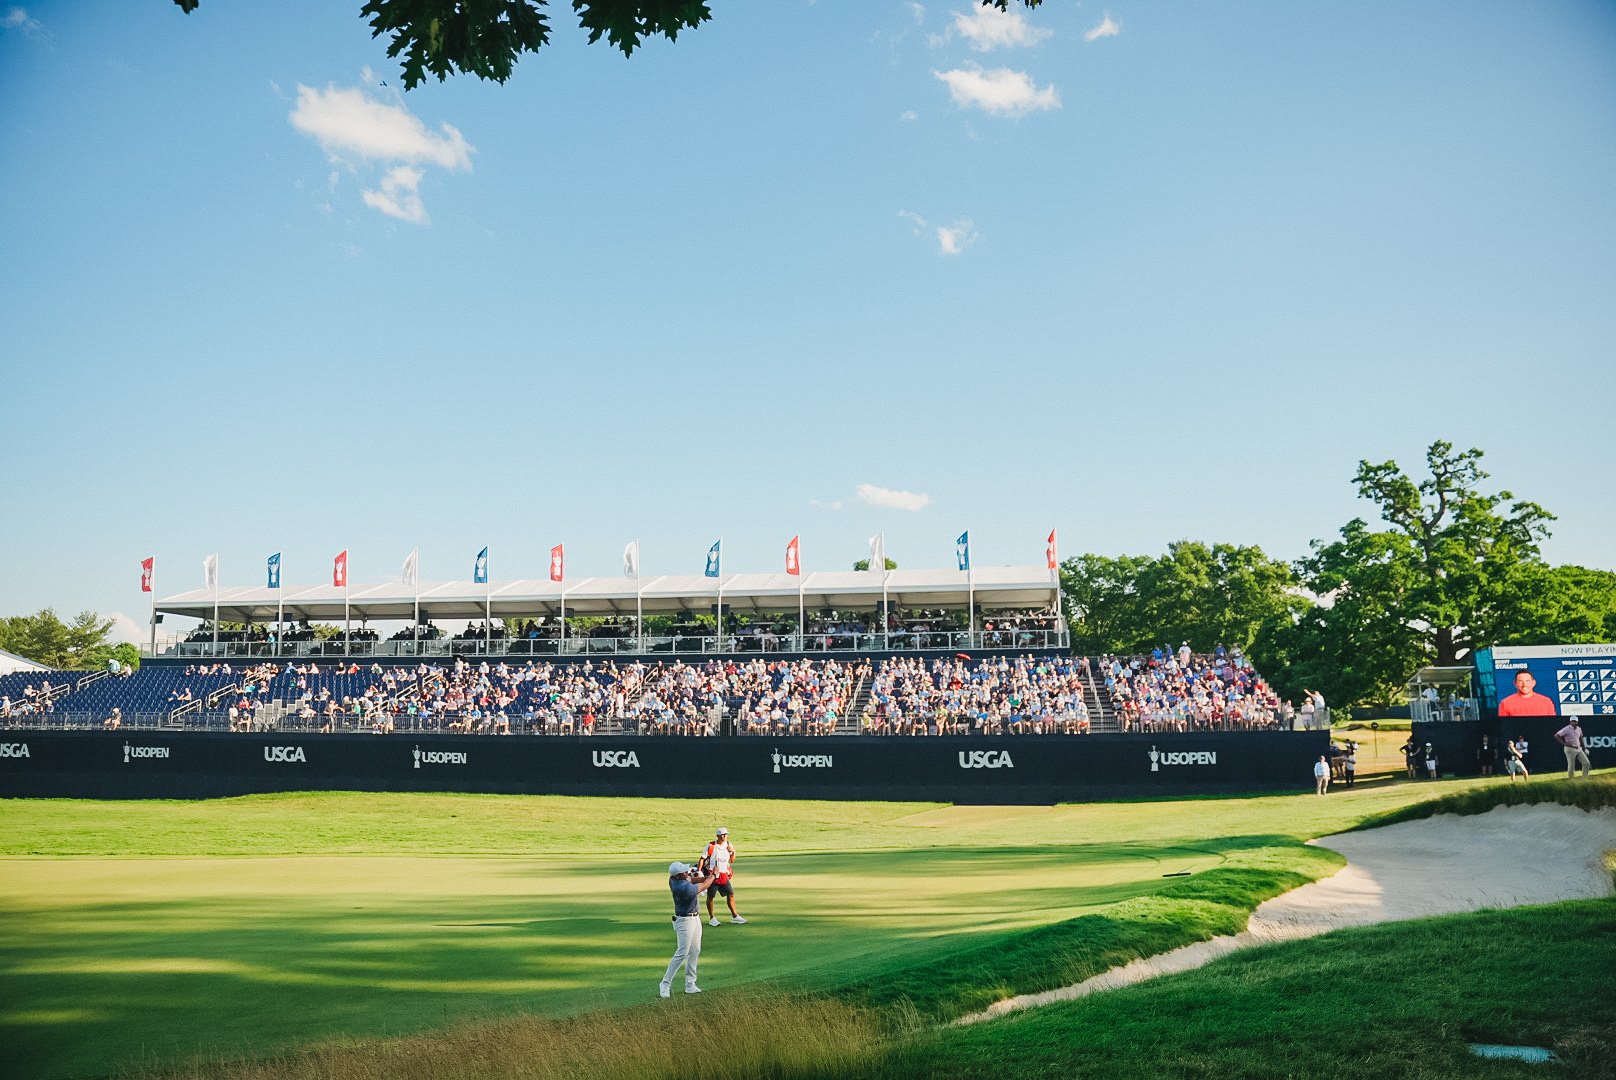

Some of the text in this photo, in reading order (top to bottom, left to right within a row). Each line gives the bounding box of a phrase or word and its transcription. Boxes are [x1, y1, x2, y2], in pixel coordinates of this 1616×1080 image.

[264, 746, 307, 763] USGA
[592, 750, 641, 768] USGA
[958, 750, 1014, 769] USGA
